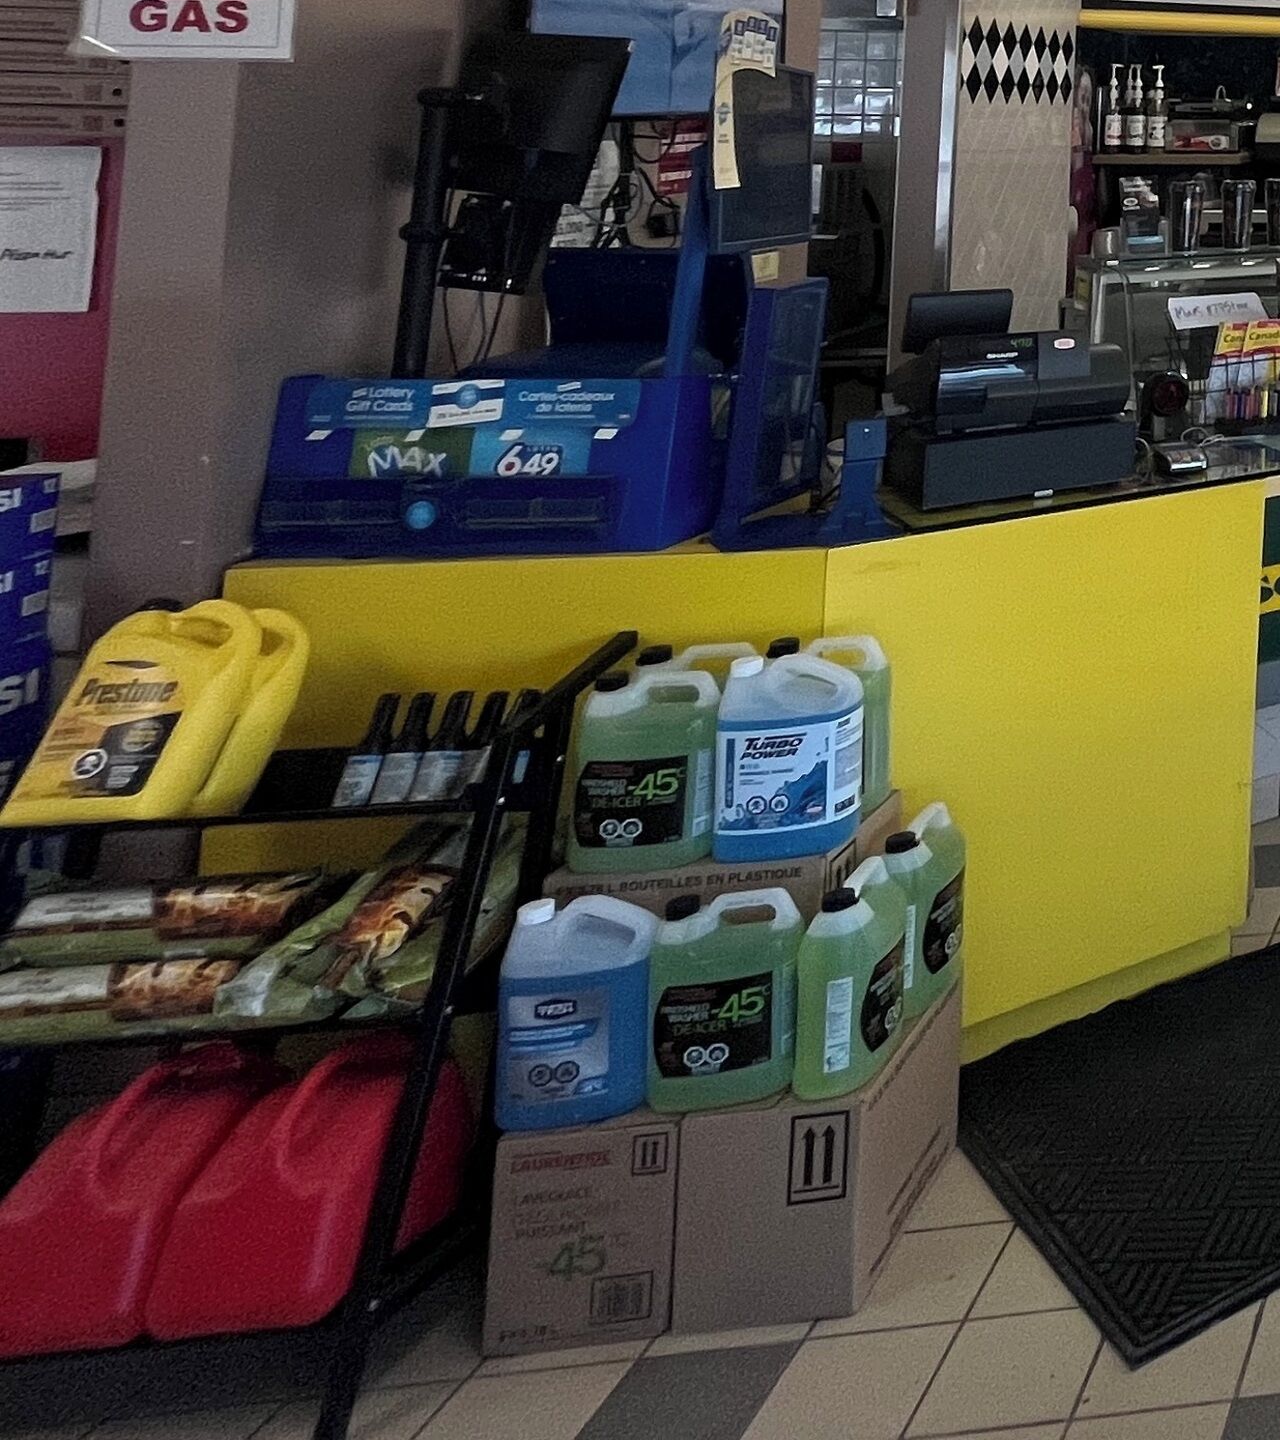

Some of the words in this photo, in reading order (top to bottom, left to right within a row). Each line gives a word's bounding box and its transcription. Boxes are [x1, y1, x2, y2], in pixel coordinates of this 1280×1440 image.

[129, 0, 248, 33] GAS
[73, 677, 179, 707] Prestone
[740, 747, 799, 761] POWER
[744, 734, 804, 751] TURBO
